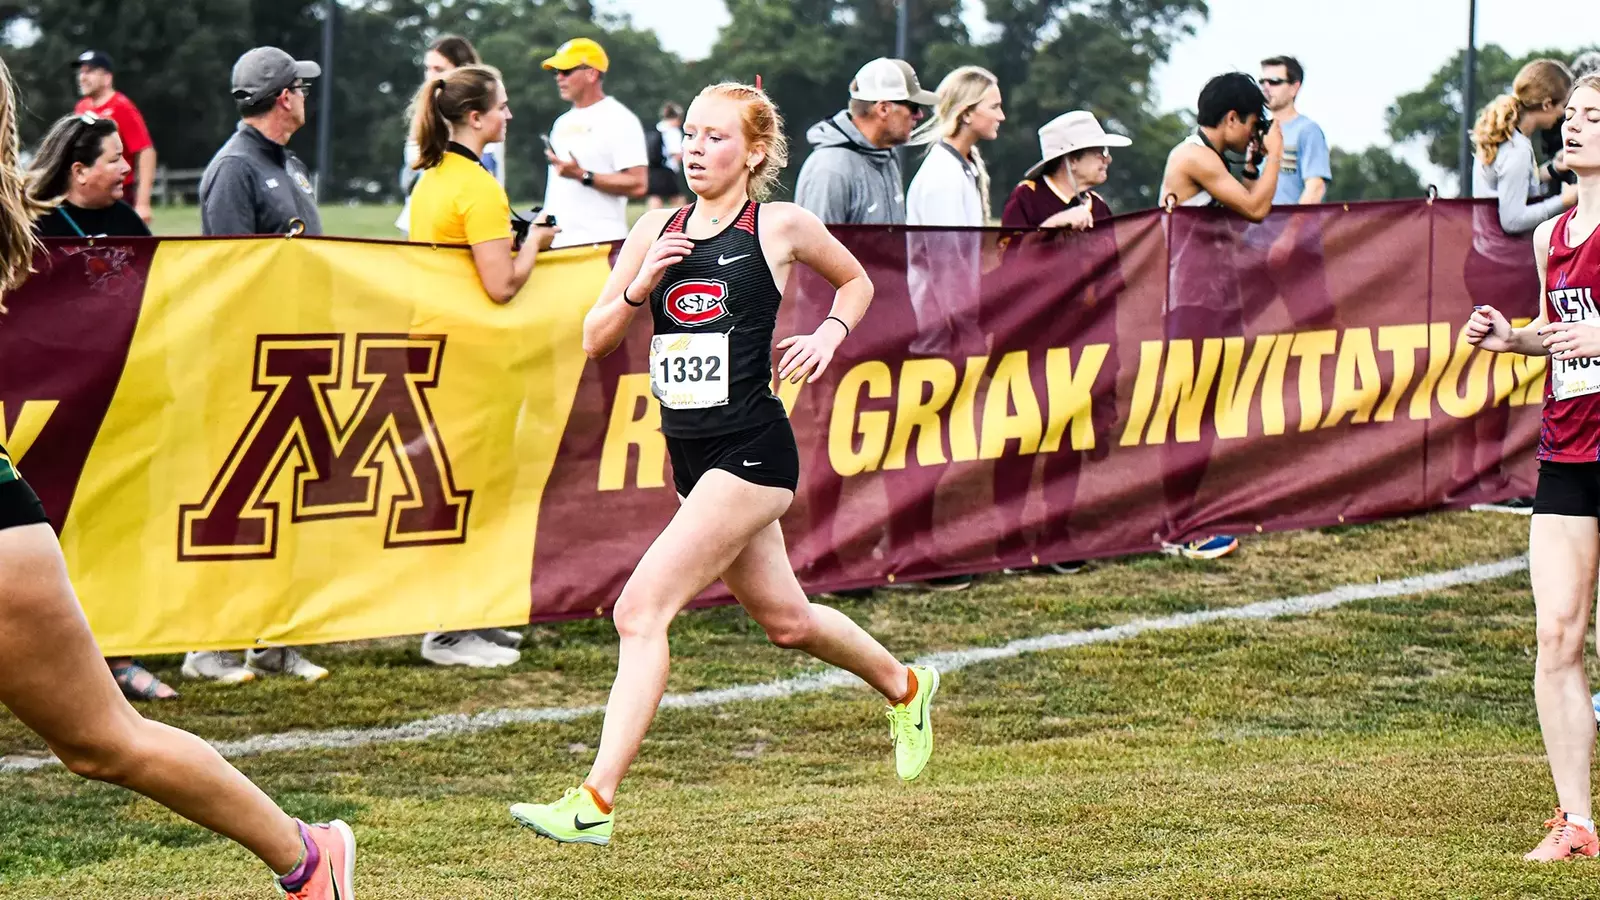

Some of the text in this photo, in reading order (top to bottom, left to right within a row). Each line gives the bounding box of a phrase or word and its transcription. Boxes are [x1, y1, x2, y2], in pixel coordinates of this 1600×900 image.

[660, 355, 721, 383] 1332
[828, 343, 1110, 477] GRIAK
[177, 332, 474, 562] M
